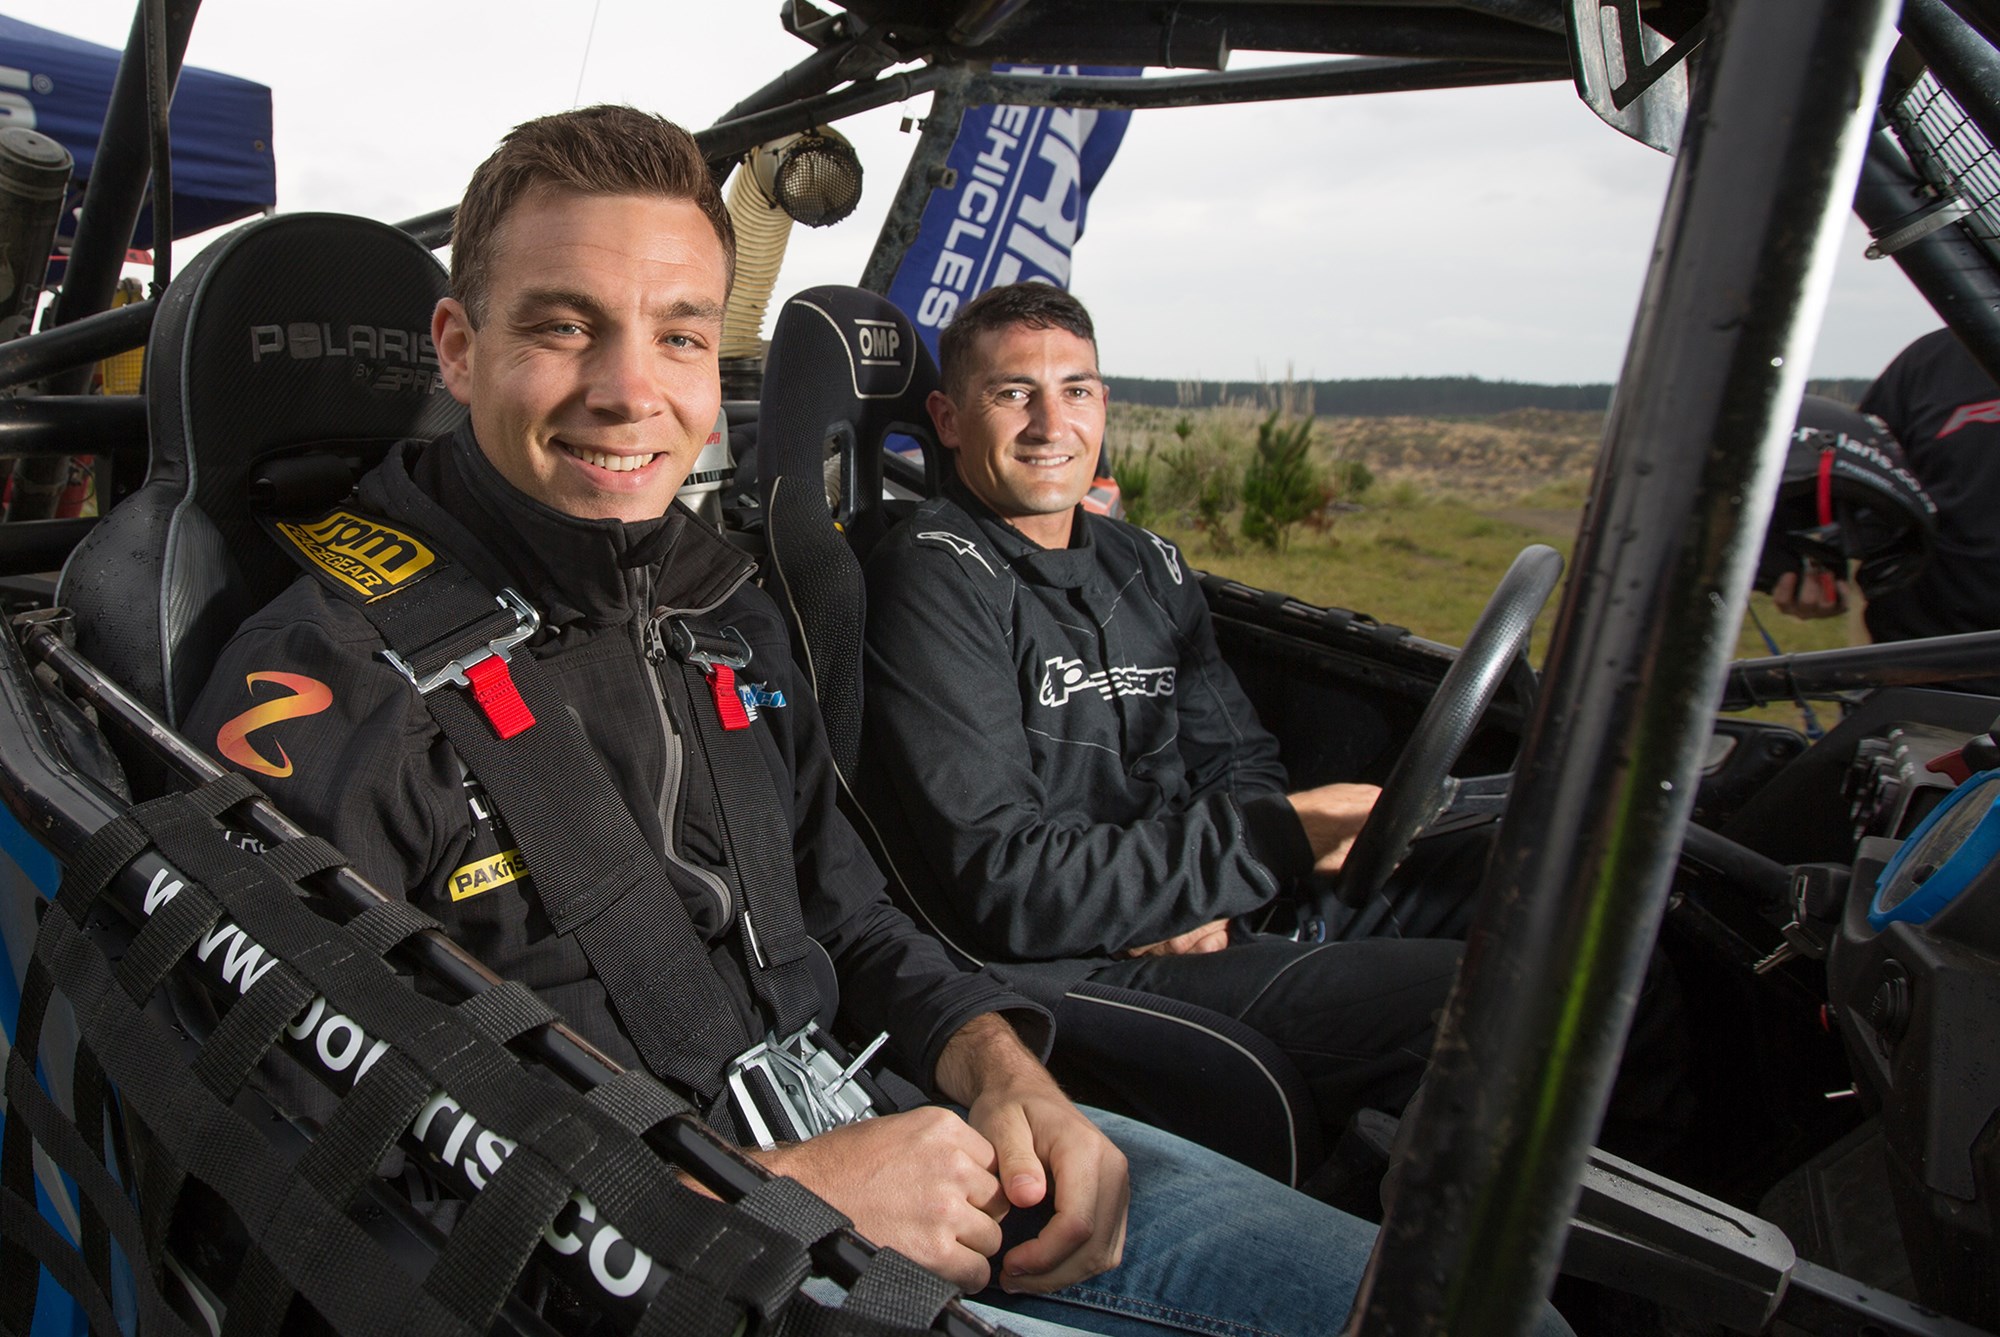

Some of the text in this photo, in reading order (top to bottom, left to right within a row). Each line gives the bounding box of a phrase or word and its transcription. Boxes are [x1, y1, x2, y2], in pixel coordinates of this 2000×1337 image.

[916, 105, 1031, 329] EHICLES
[858, 327, 900, 357] OMP
[286, 524, 383, 588] RACEGEAR
[314, 516, 418, 573] rpm
